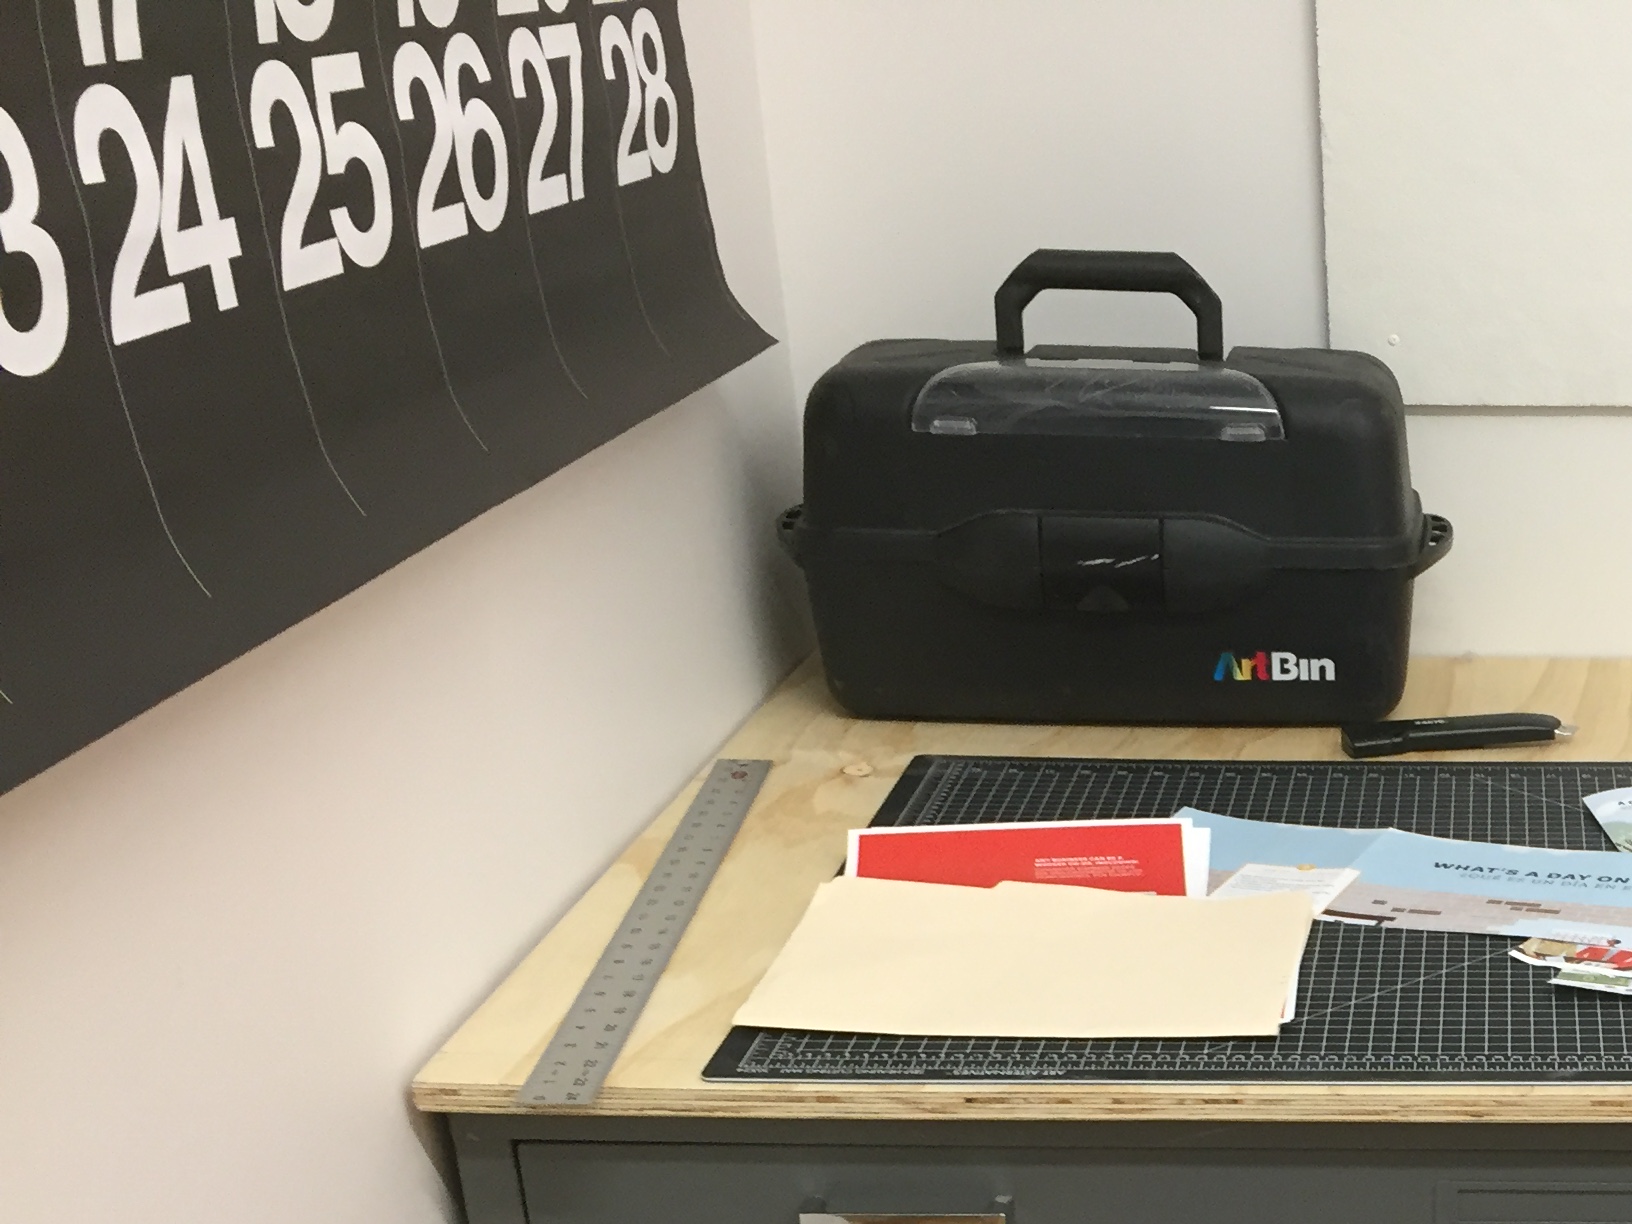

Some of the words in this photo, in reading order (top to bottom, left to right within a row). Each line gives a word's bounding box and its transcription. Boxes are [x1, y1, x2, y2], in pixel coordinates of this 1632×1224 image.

[0, 106, 69, 376] 3
[74, 74, 242, 345] 24
[250, 52, 393, 291] 25
[393, 32, 509, 248] 26
[508, 22, 585, 214] 27
[600, 8, 678, 186] 28
[1213, 651, 1336, 681] ArtBin
[1434, 862, 1519, 877] WHAT'S
[1547, 872, 1592, 881] DAY
[1597, 875, 1630, 885] ON
